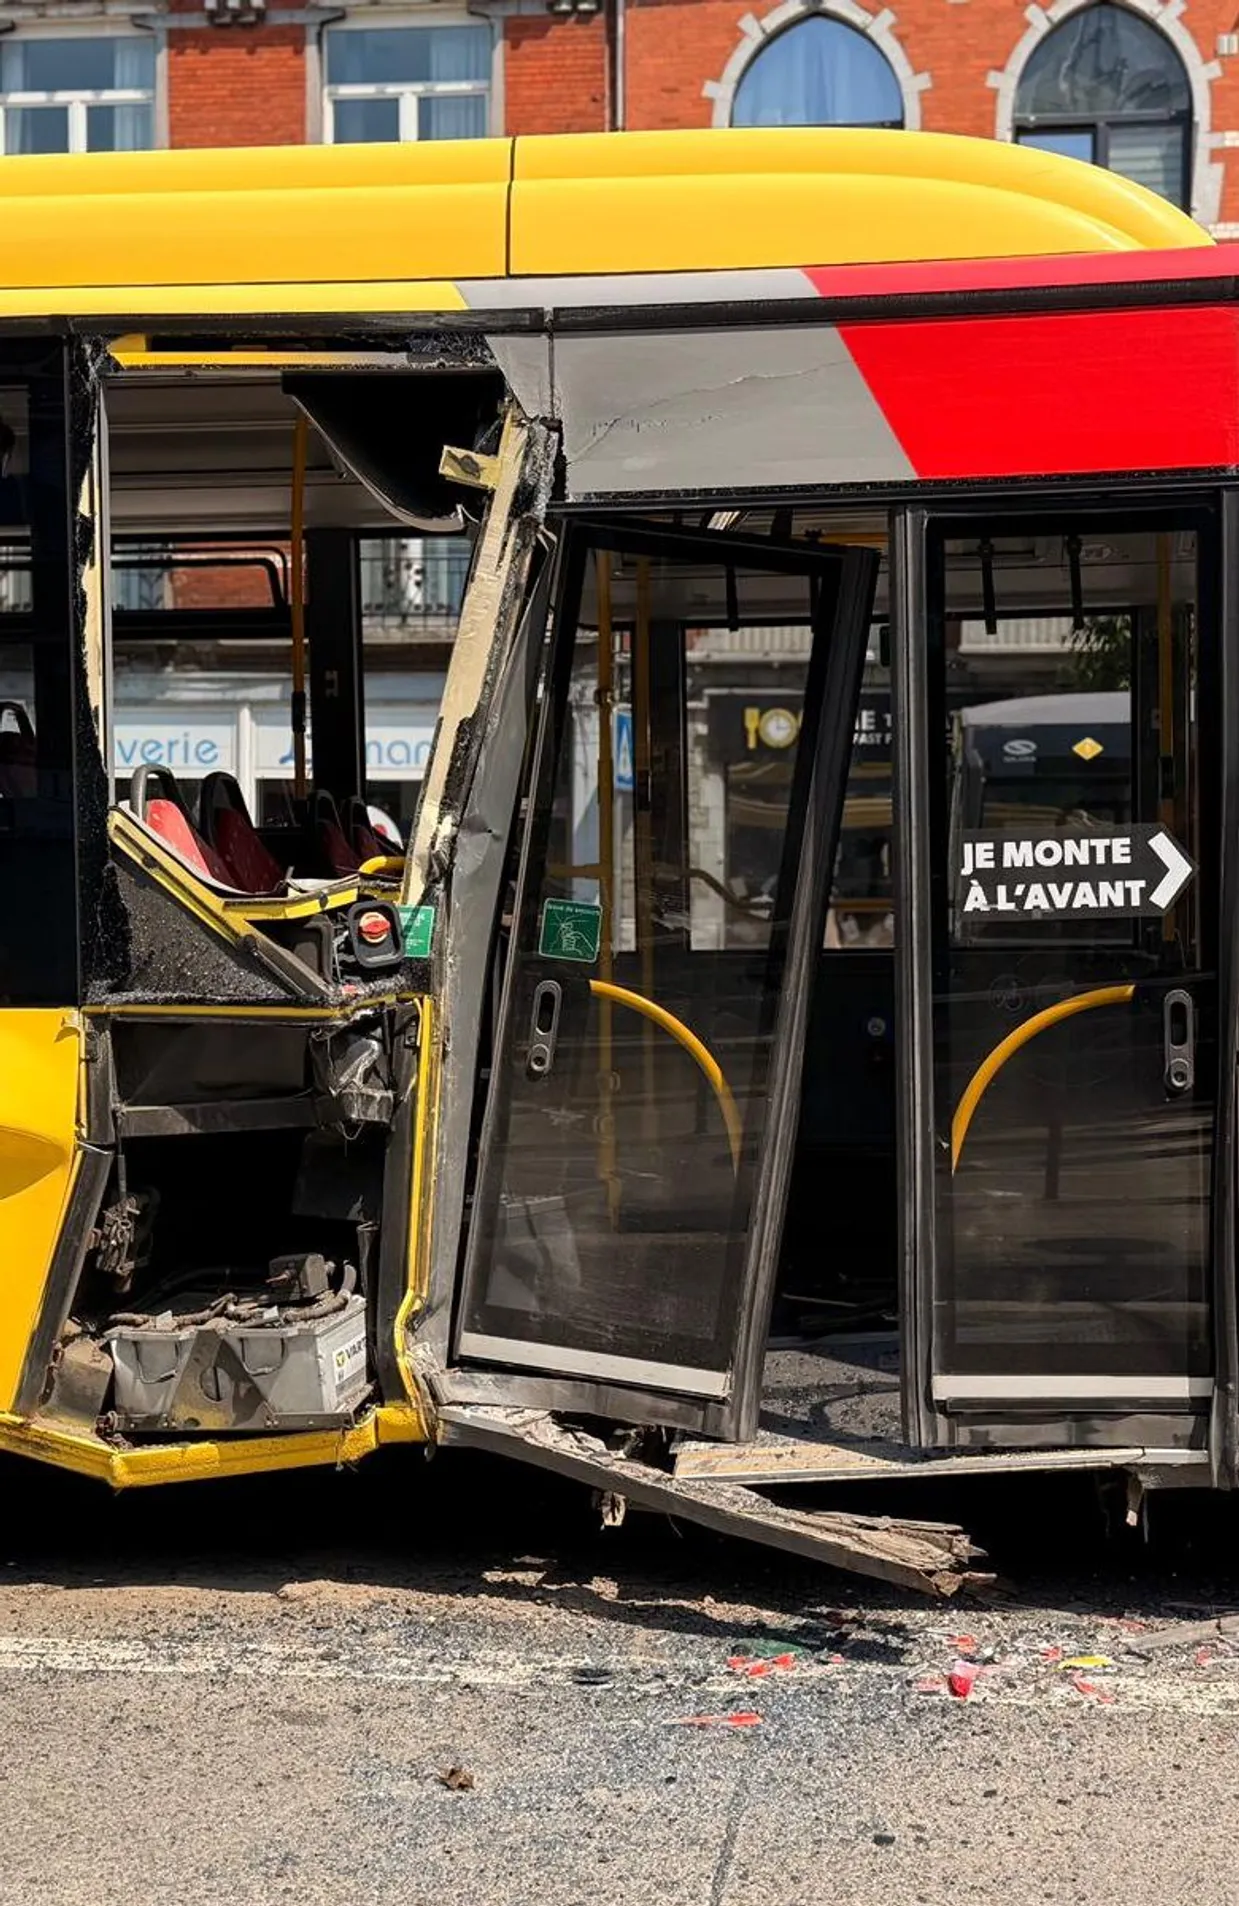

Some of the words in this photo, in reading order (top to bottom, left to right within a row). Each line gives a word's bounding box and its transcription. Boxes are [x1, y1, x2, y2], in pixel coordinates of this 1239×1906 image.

[117, 732, 219, 764] verie
[961, 842, 995, 876] JE
[1002, 837, 1132, 868] MONTE
[963, 879, 990, 912] À
[996, 880, 1146, 911] L'AVANT
